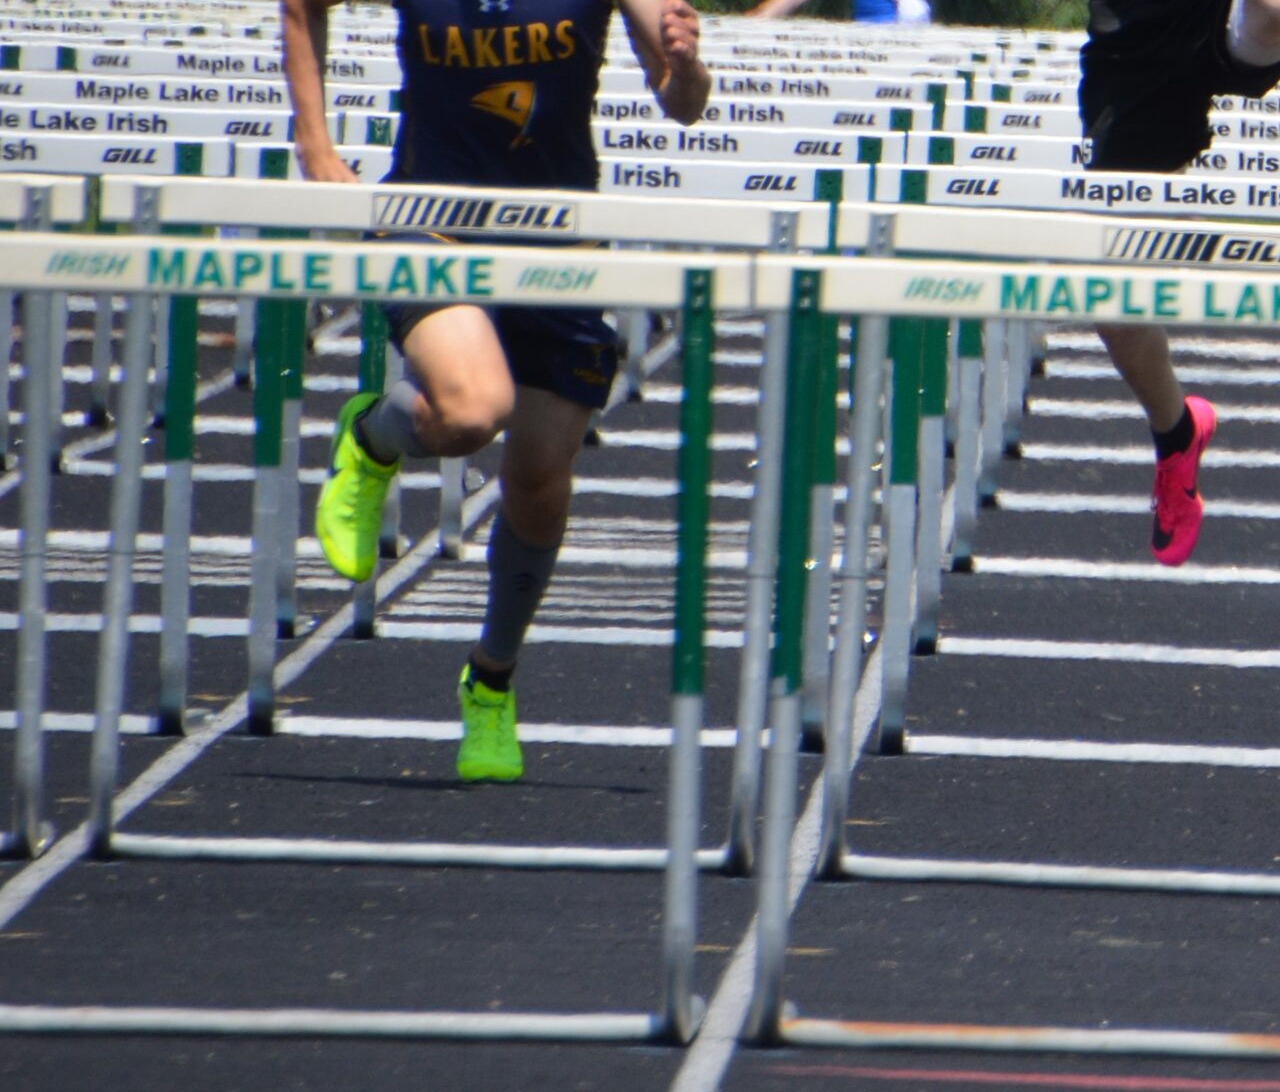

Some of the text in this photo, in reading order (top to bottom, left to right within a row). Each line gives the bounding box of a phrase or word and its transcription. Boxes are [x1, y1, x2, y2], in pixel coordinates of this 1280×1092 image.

[418, 19, 577, 68] LAKERS
[177, 55, 245, 74] Maple
[76, 80, 282, 104] Maple Lake Irish
[719, 77, 830, 96] Lake Irish
[334, 94, 376, 108] GILL
[30, 109, 97, 131] Lake
[107, 112, 168, 134] Irish
[595, 101, 652, 120] aple
[730, 104, 784, 123] Irish
[1001, 114, 1042, 128] GILL
[224, 121, 273, 137] GILL
[604, 129, 738, 152] Lake Irish
[794, 141, 843, 157] GILL
[101, 147, 157, 164] GILL
[970, 145, 1017, 161] GILL
[613, 163, 681, 189] Irish
[744, 174, 798, 191] GILL
[946, 179, 1000, 196] GILL
[1060, 178, 1152, 207] Maple
[1163, 181, 1236, 206] Lake
[494, 203, 571, 229] GILL
[45, 247, 598, 296] IRISH MAPLE LAKE IRISH
[904, 277, 984, 303] IRISH
[1000, 273, 1181, 317] MAPLE
